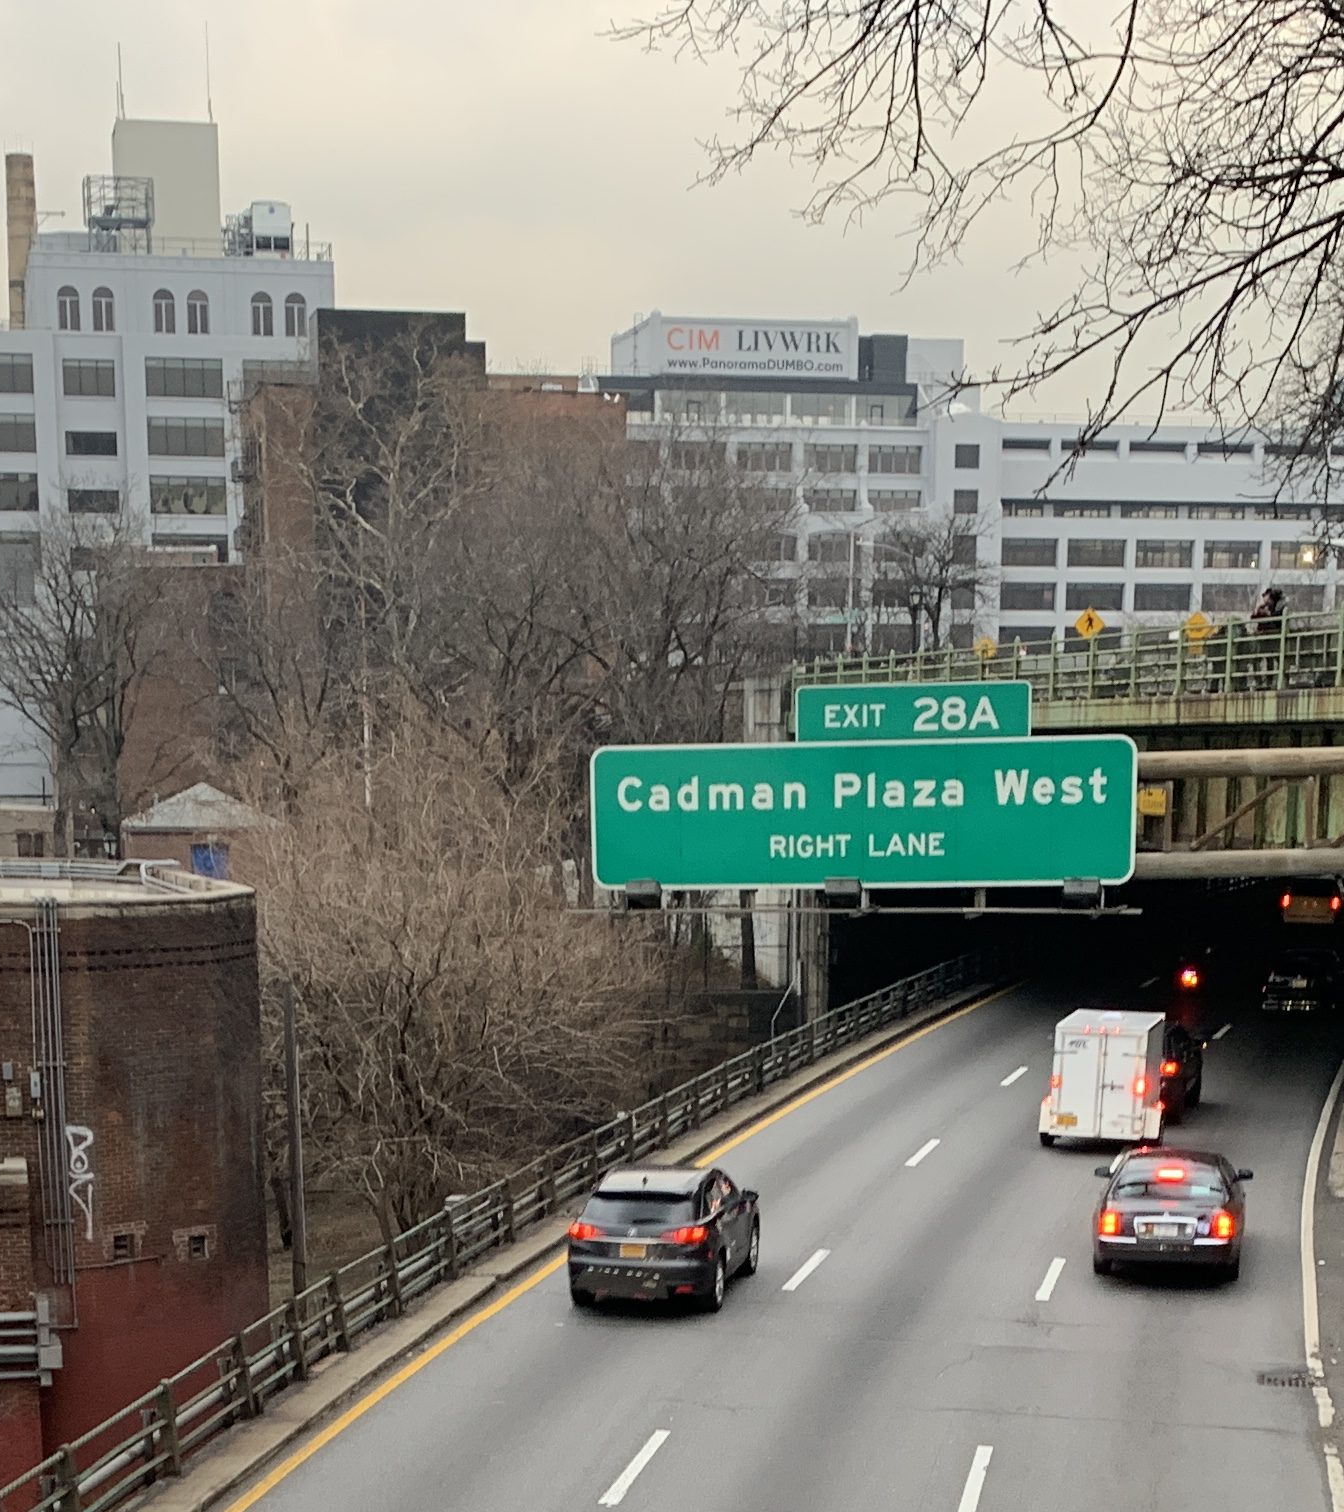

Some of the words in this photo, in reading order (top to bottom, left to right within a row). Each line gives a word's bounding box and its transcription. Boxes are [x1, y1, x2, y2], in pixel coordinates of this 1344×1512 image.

[667, 327, 720, 352] CIM
[737, 329, 842, 353] LIVWRK
[667, 357, 843, 372] www.PanoramaDUMBO.com
[824, 703, 886, 728] EXIT
[913, 696, 1000, 732] 28A
[617, 775, 806, 812] Cadman
[834, 772, 965, 809] Plaza
[994, 767, 1107, 805] West
[770, 834, 851, 858] RIGHT
[868, 832, 945, 857] LANE
